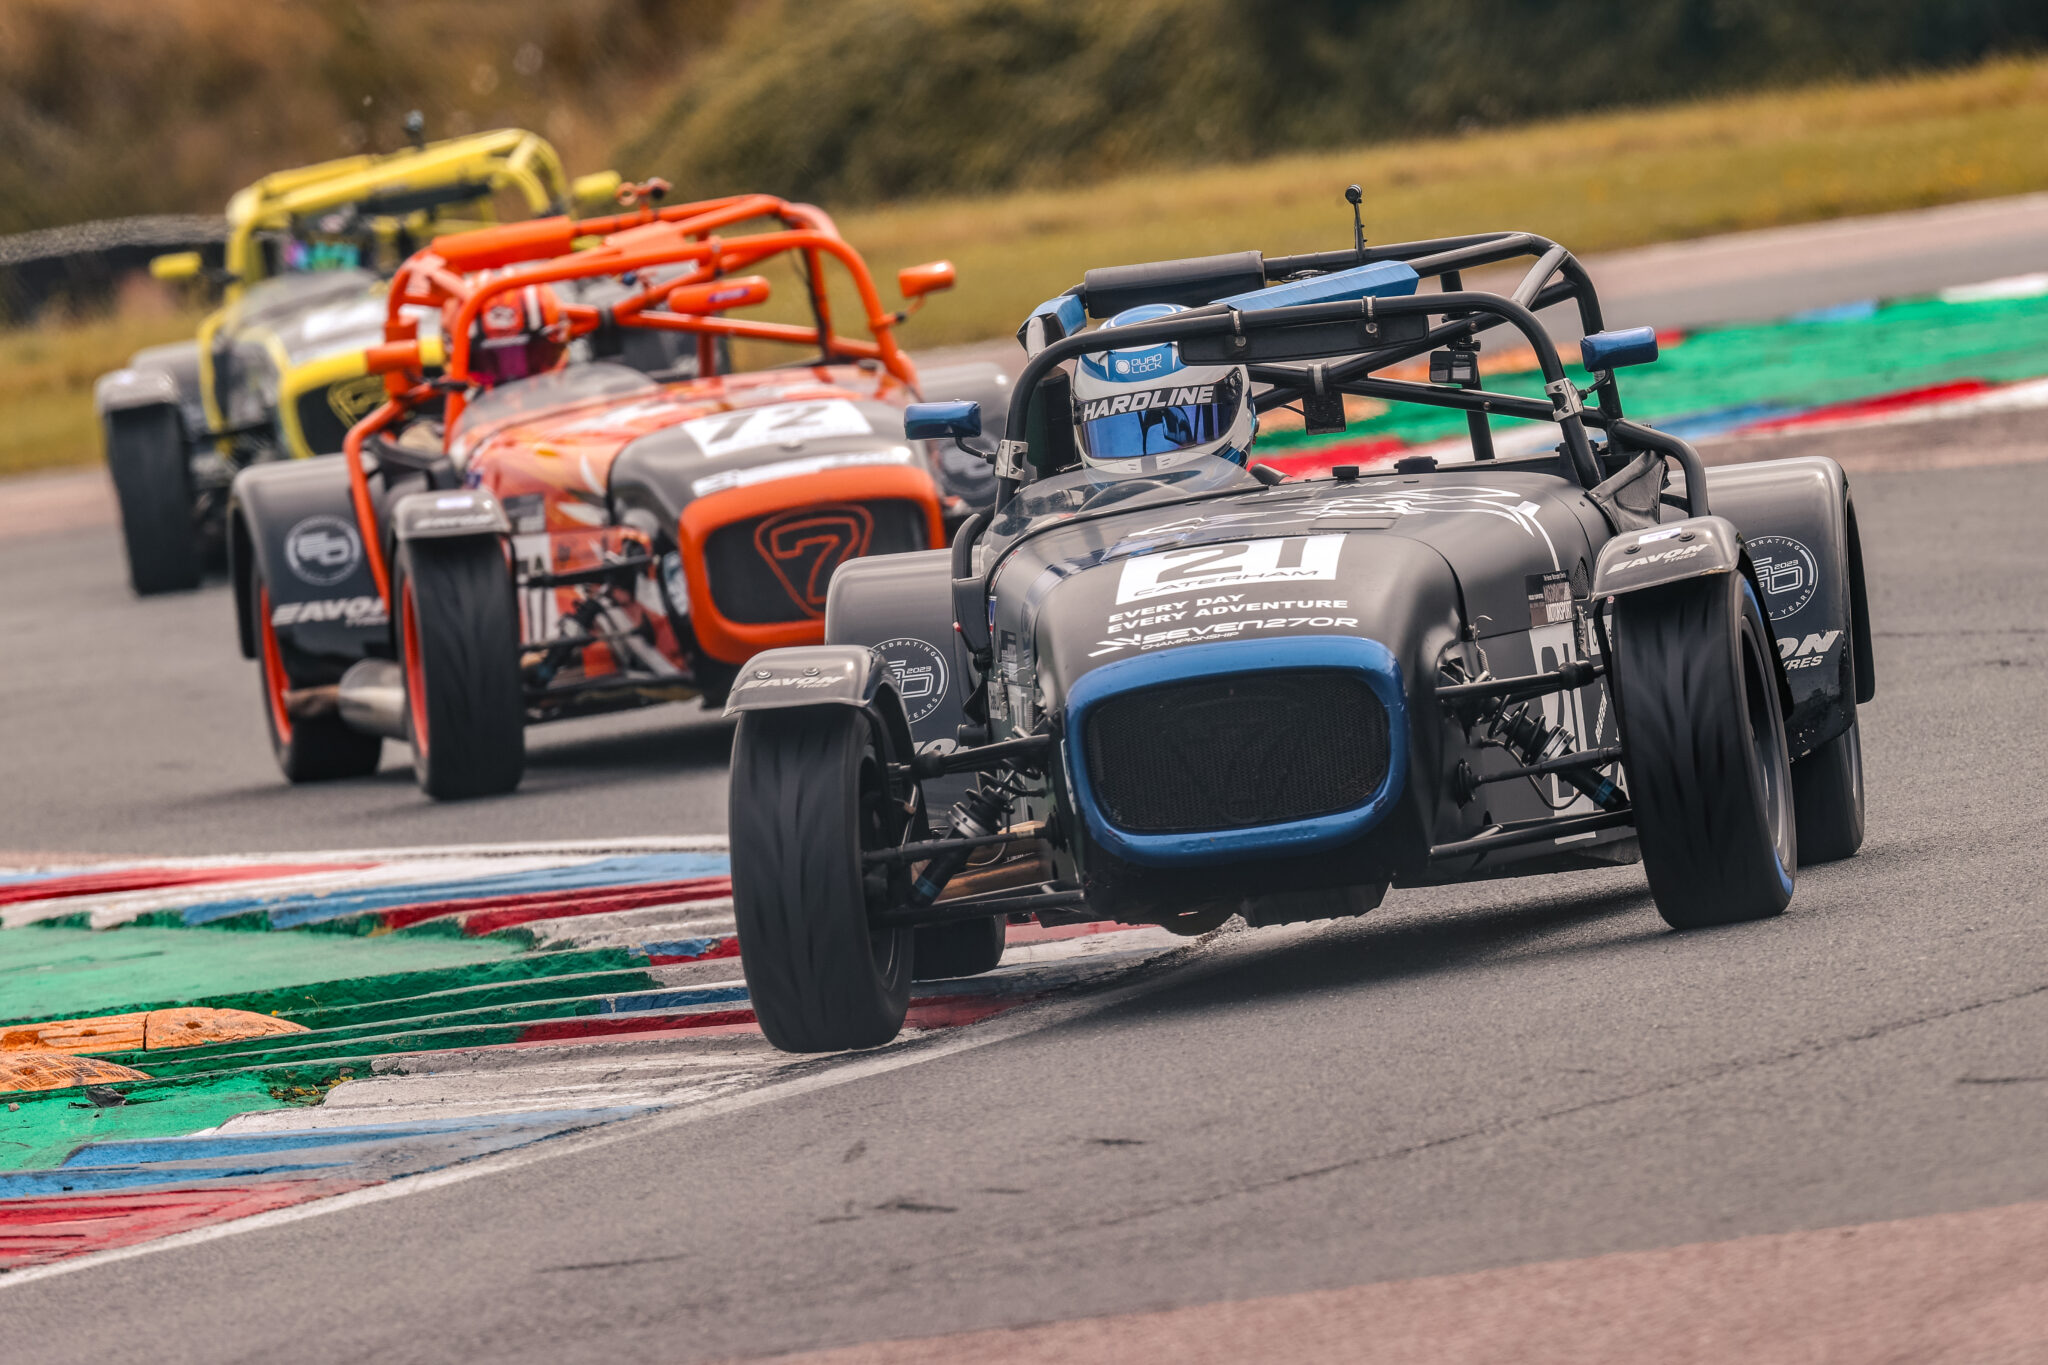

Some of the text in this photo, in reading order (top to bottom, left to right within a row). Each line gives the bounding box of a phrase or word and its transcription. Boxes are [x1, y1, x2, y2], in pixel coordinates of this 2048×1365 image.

[1131, 353, 1162, 367] QUAD
[1131, 362, 1162, 374] LOCK
[1083, 385, 1215, 422] HARDLINE
[1627, 543, 1710, 569] AVON
[1750, 539, 1801, 551] BRATING
[1155, 538, 1309, 583] 21
[1774, 559, 1799, 570] 2023
[1133, 569, 1319, 597] CATERHAM
[1108, 593, 1246, 623] EVERY DAY
[1781, 589, 1811, 615] YEARS
[1107, 599, 1348, 634] EVERY ADVENTURE
[881, 640, 936, 657] EBRATING
[1141, 631, 1240, 650] CHAMPIONSHIP
[1776, 630, 1840, 660] ON
[907, 665, 932, 674] 2023
